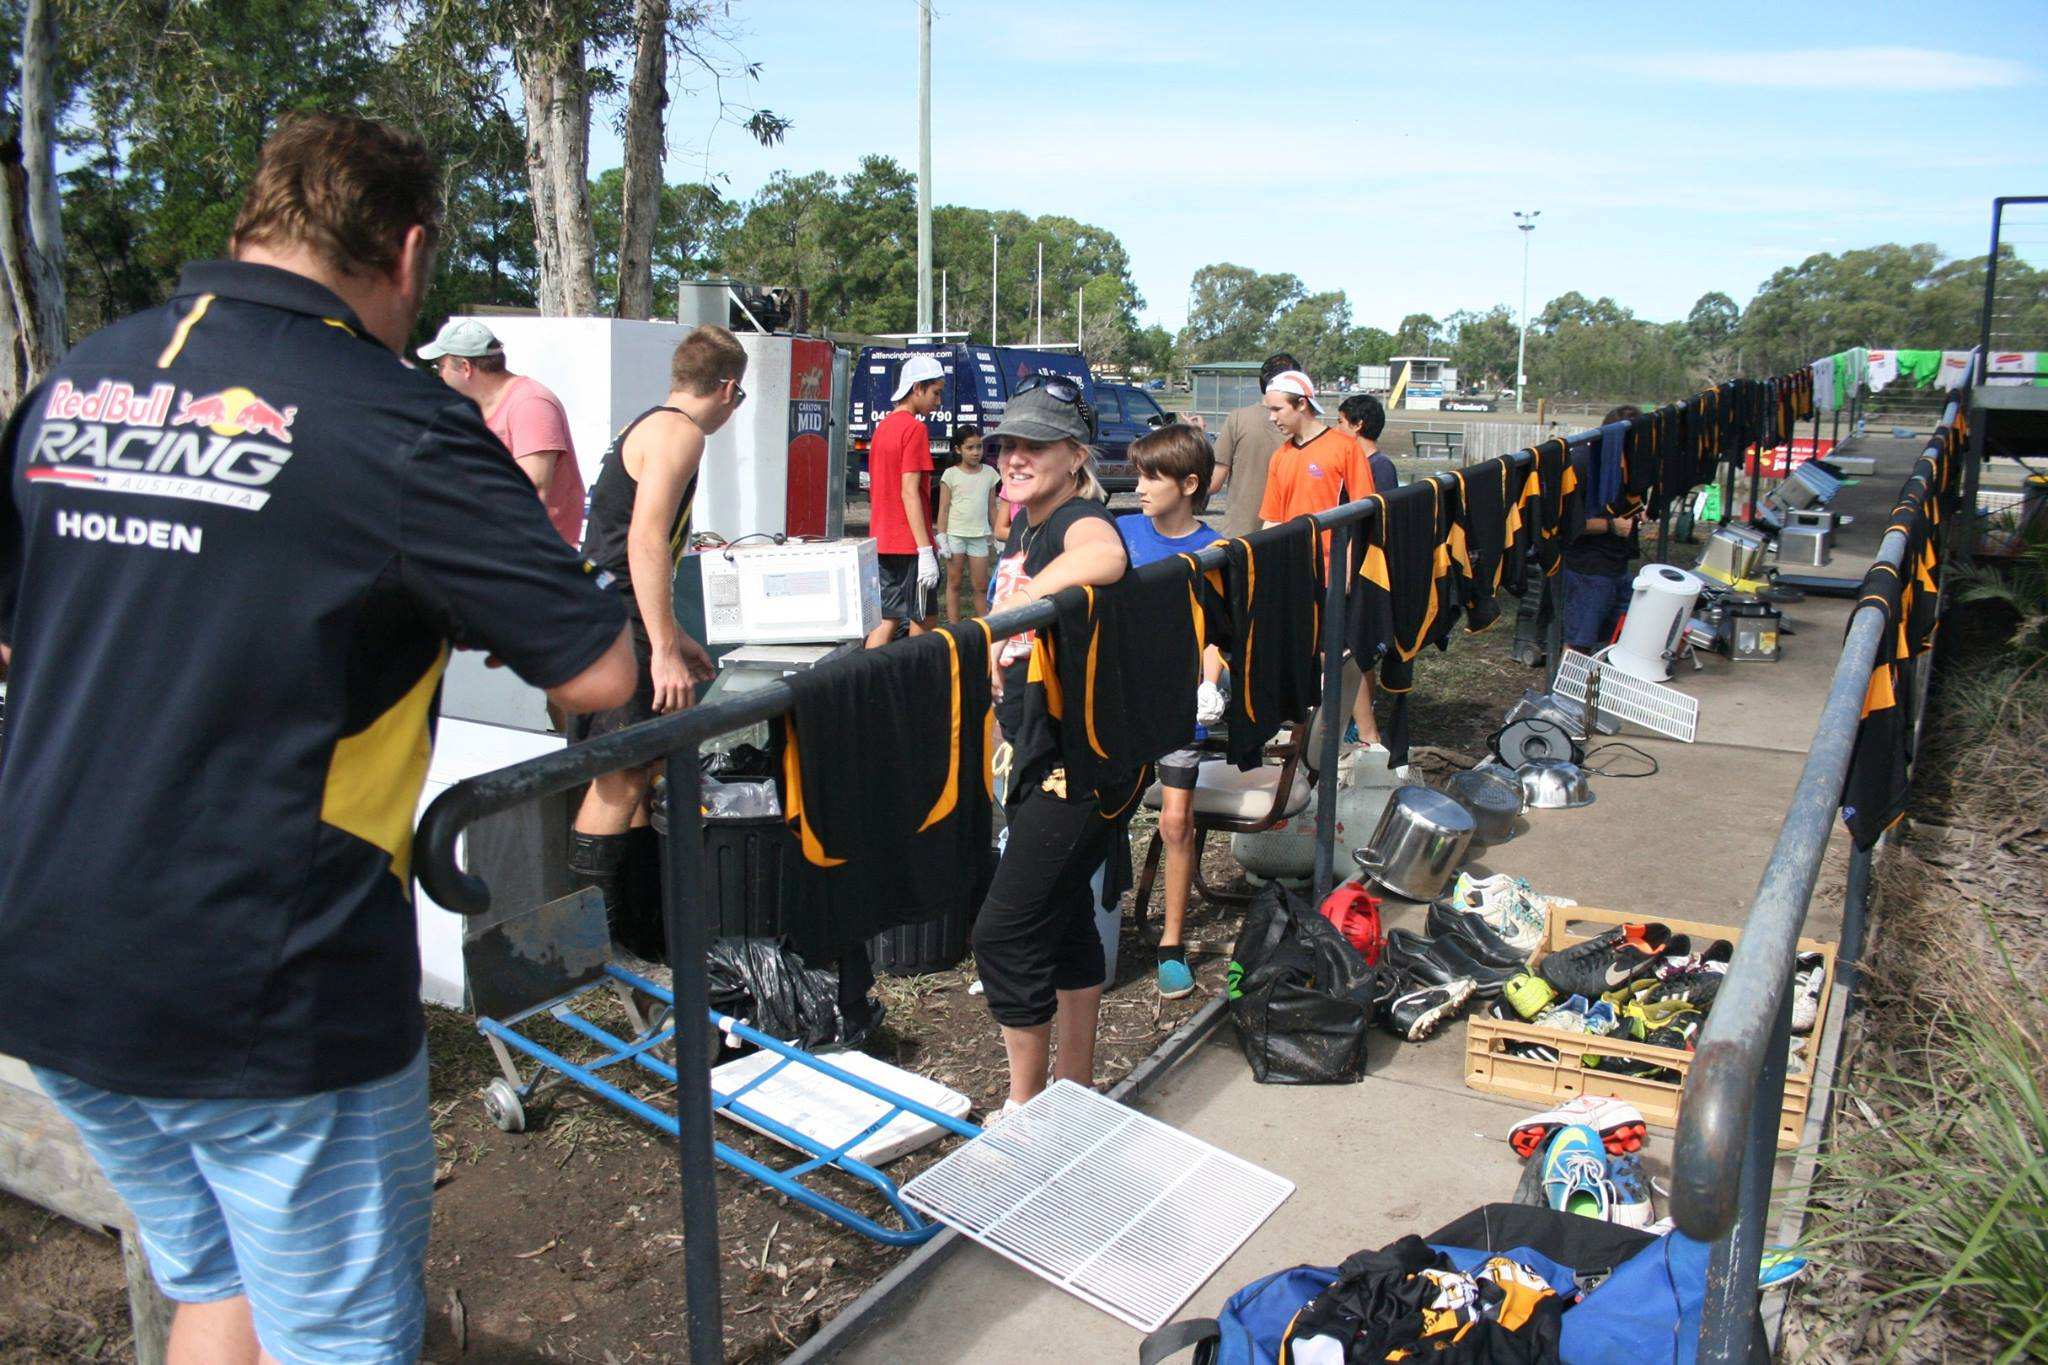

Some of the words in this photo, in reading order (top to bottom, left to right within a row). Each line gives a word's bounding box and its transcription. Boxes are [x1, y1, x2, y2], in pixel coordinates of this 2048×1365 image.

[798, 401, 821, 411] CARLTON
[930, 411, 952, 422] 790
[797, 413, 822, 433] MID
[29, 422, 293, 486] RACING
[120, 479, 253, 505] AUSTRALIA
[57, 510, 203, 554] HOLDEN
